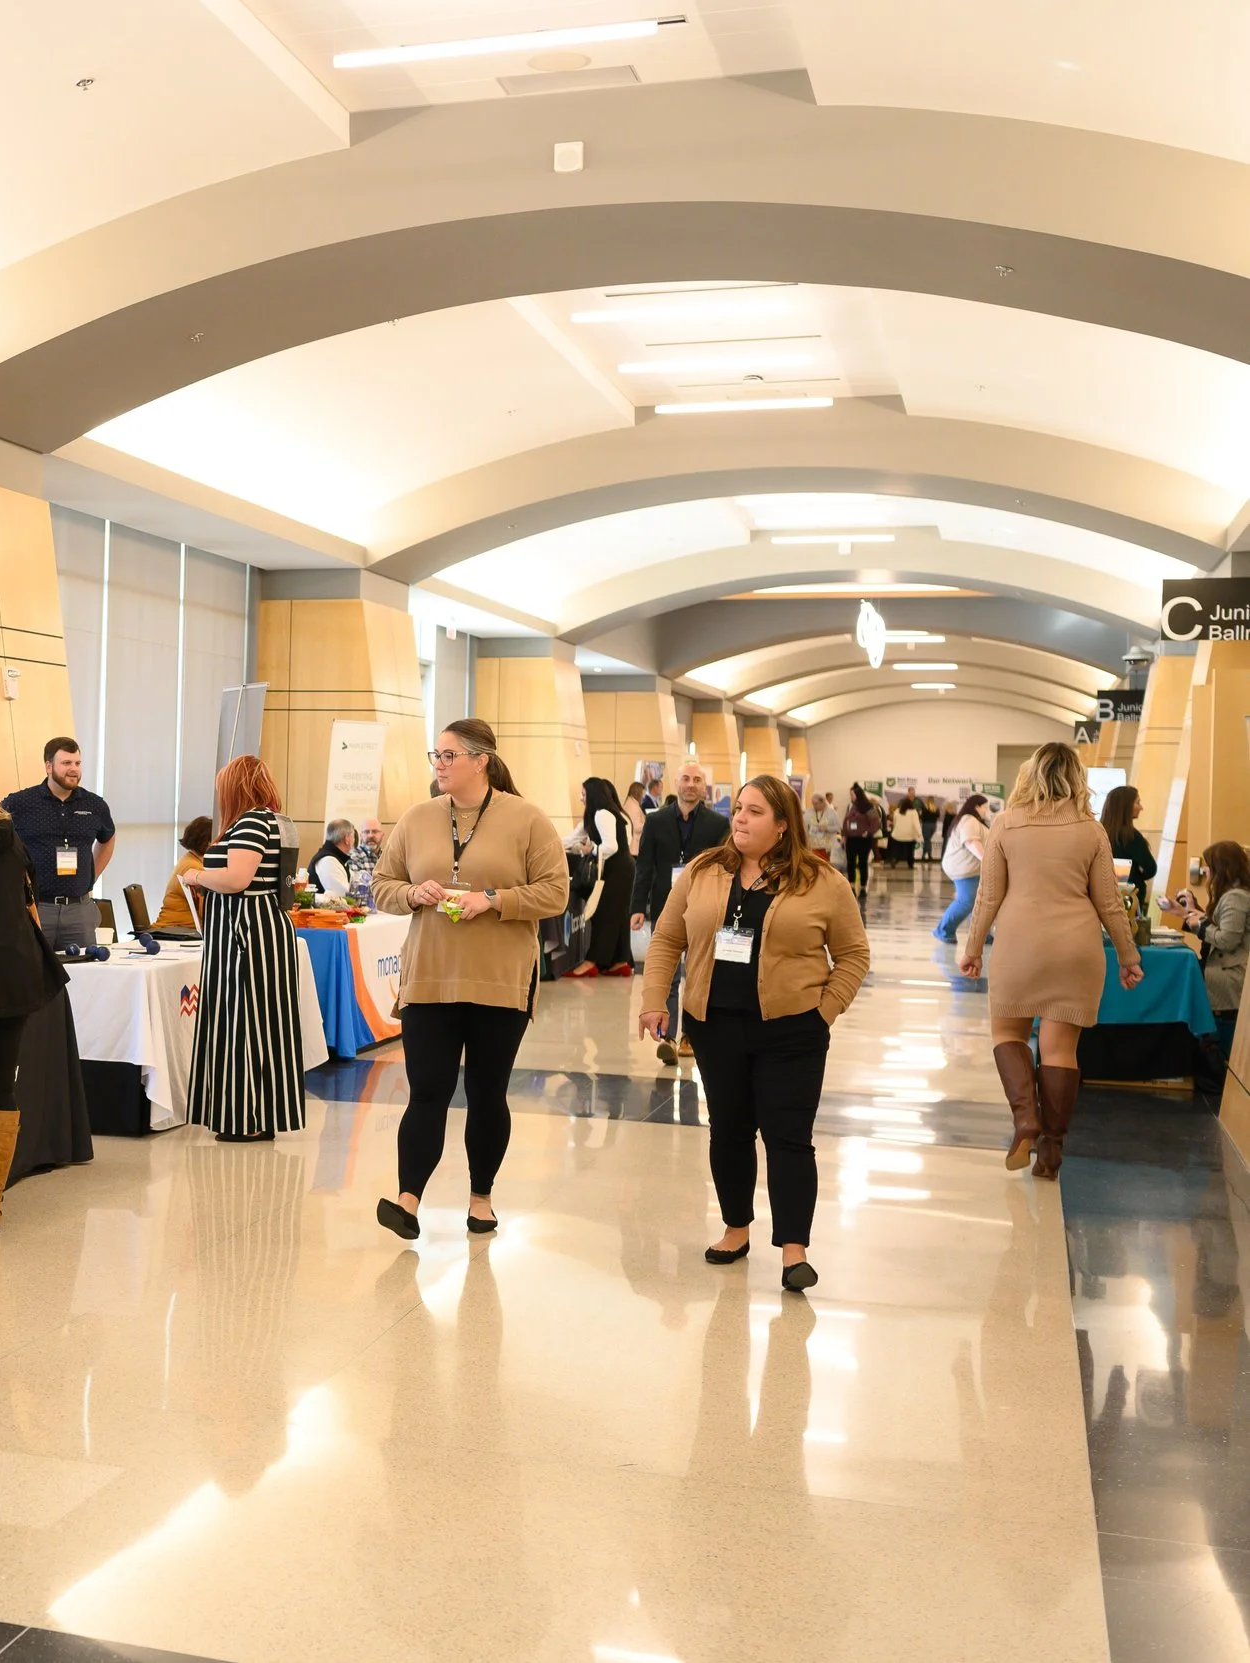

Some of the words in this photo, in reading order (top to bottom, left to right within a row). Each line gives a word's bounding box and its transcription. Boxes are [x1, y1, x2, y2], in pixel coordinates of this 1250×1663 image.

[1161, 596, 1203, 641] C
[1095, 698, 1115, 722] B
[1074, 726, 1091, 745] A
